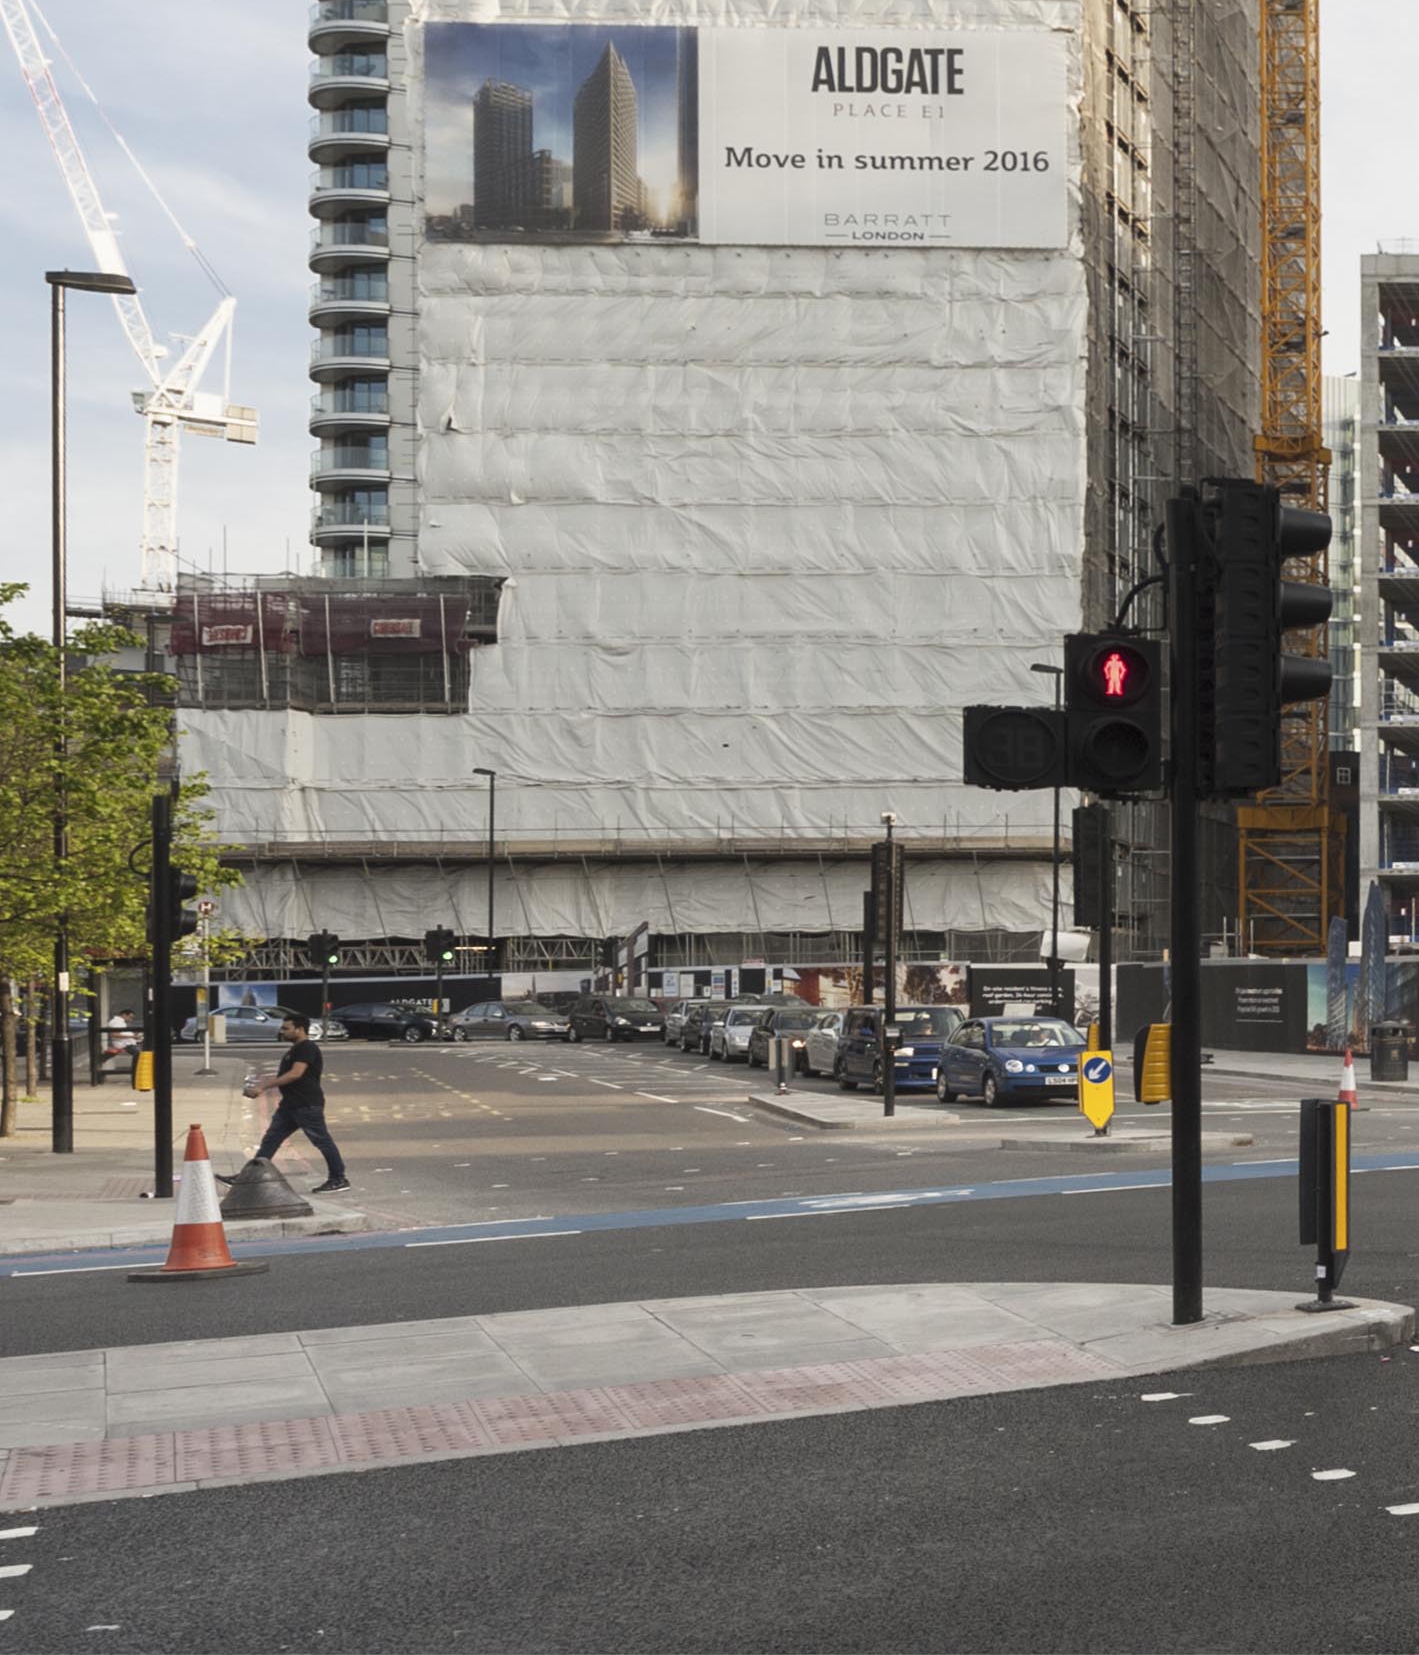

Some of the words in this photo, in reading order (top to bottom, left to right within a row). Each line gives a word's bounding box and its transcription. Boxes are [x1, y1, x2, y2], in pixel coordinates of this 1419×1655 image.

[811, 46, 964, 94] ALDGATE
[833, 103, 907, 118] PLACE
[725, 147, 805, 168] Move
[816, 148, 844, 169] in
[855, 152, 974, 171] summer
[983, 151, 1049, 171] 2016
[824, 213, 951, 227] BARRATT
[852, 232, 925, 241] LONDON
